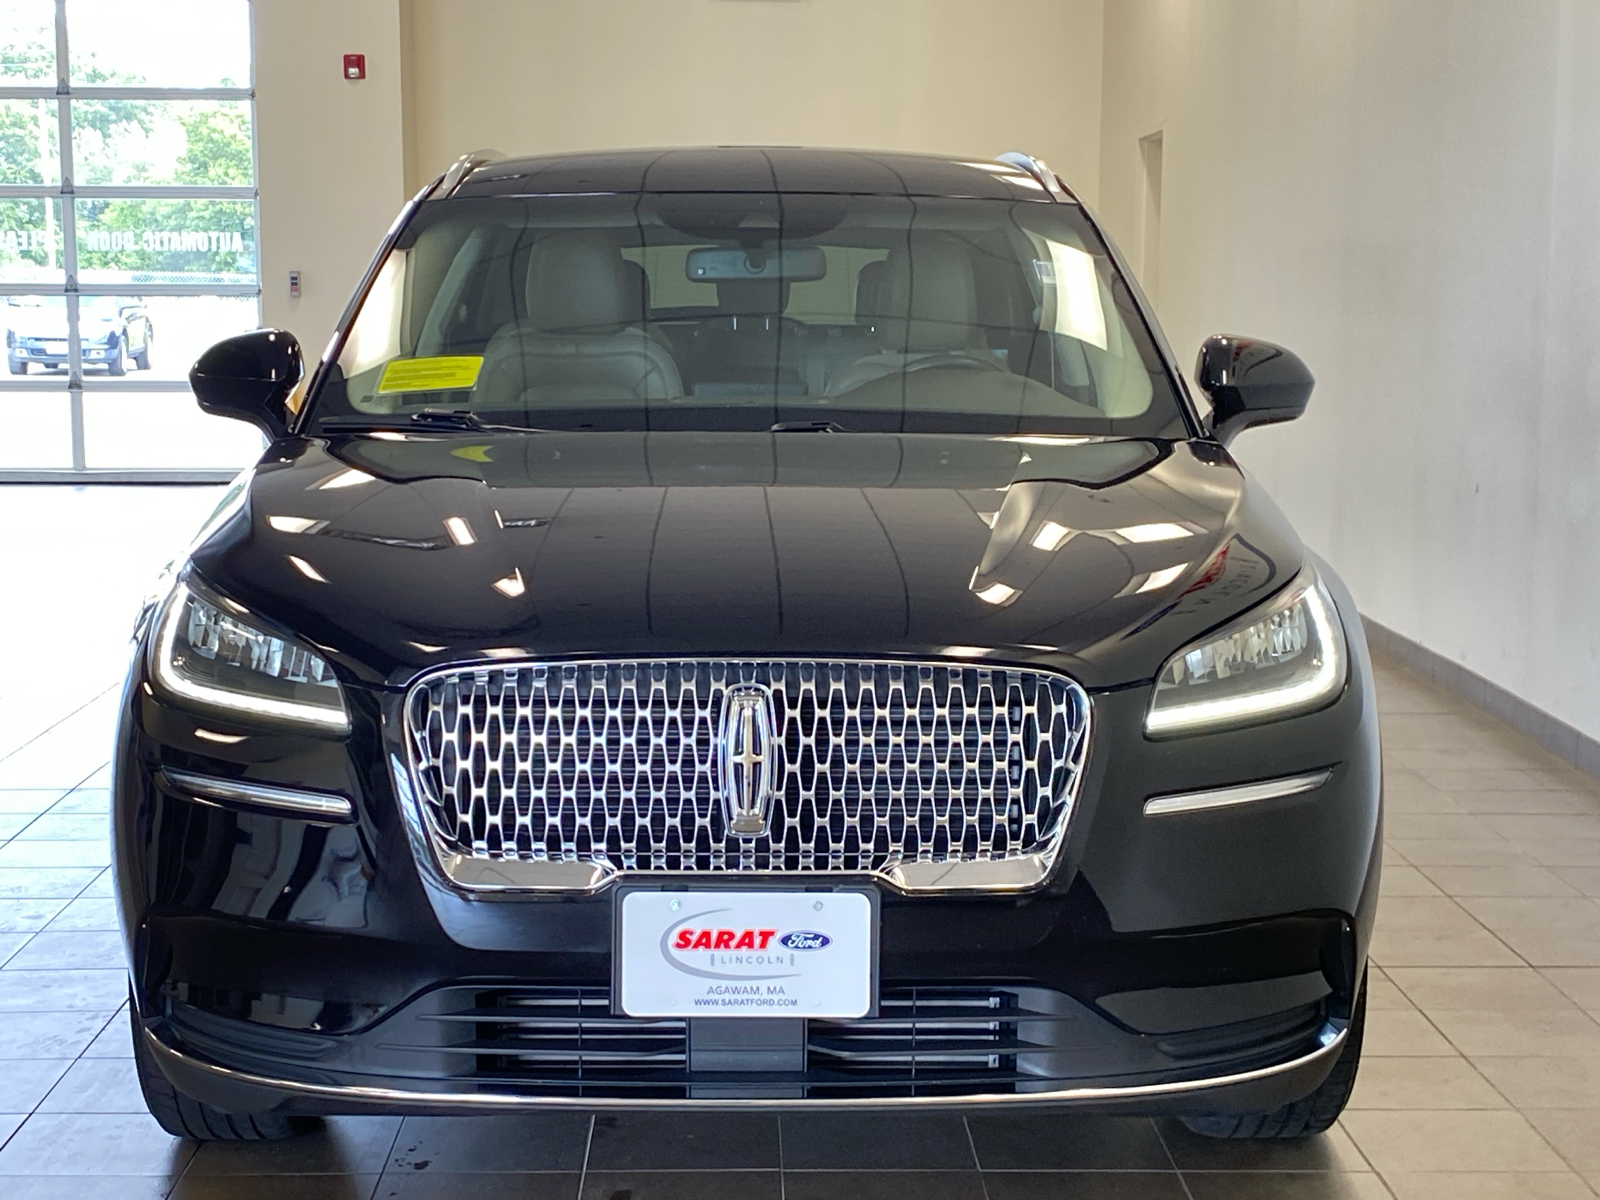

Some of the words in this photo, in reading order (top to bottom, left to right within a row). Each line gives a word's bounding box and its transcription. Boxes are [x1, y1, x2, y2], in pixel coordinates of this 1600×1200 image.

[673, 929, 777, 950] SARAT
[786, 933, 823, 951] Ford
[720, 955, 785, 965] LINCOLN
[706, 985, 763, 996] AGAWAM,
[766, 985, 786, 995] MA
[693, 998, 798, 1007] WWW.SARATFORD.COM
